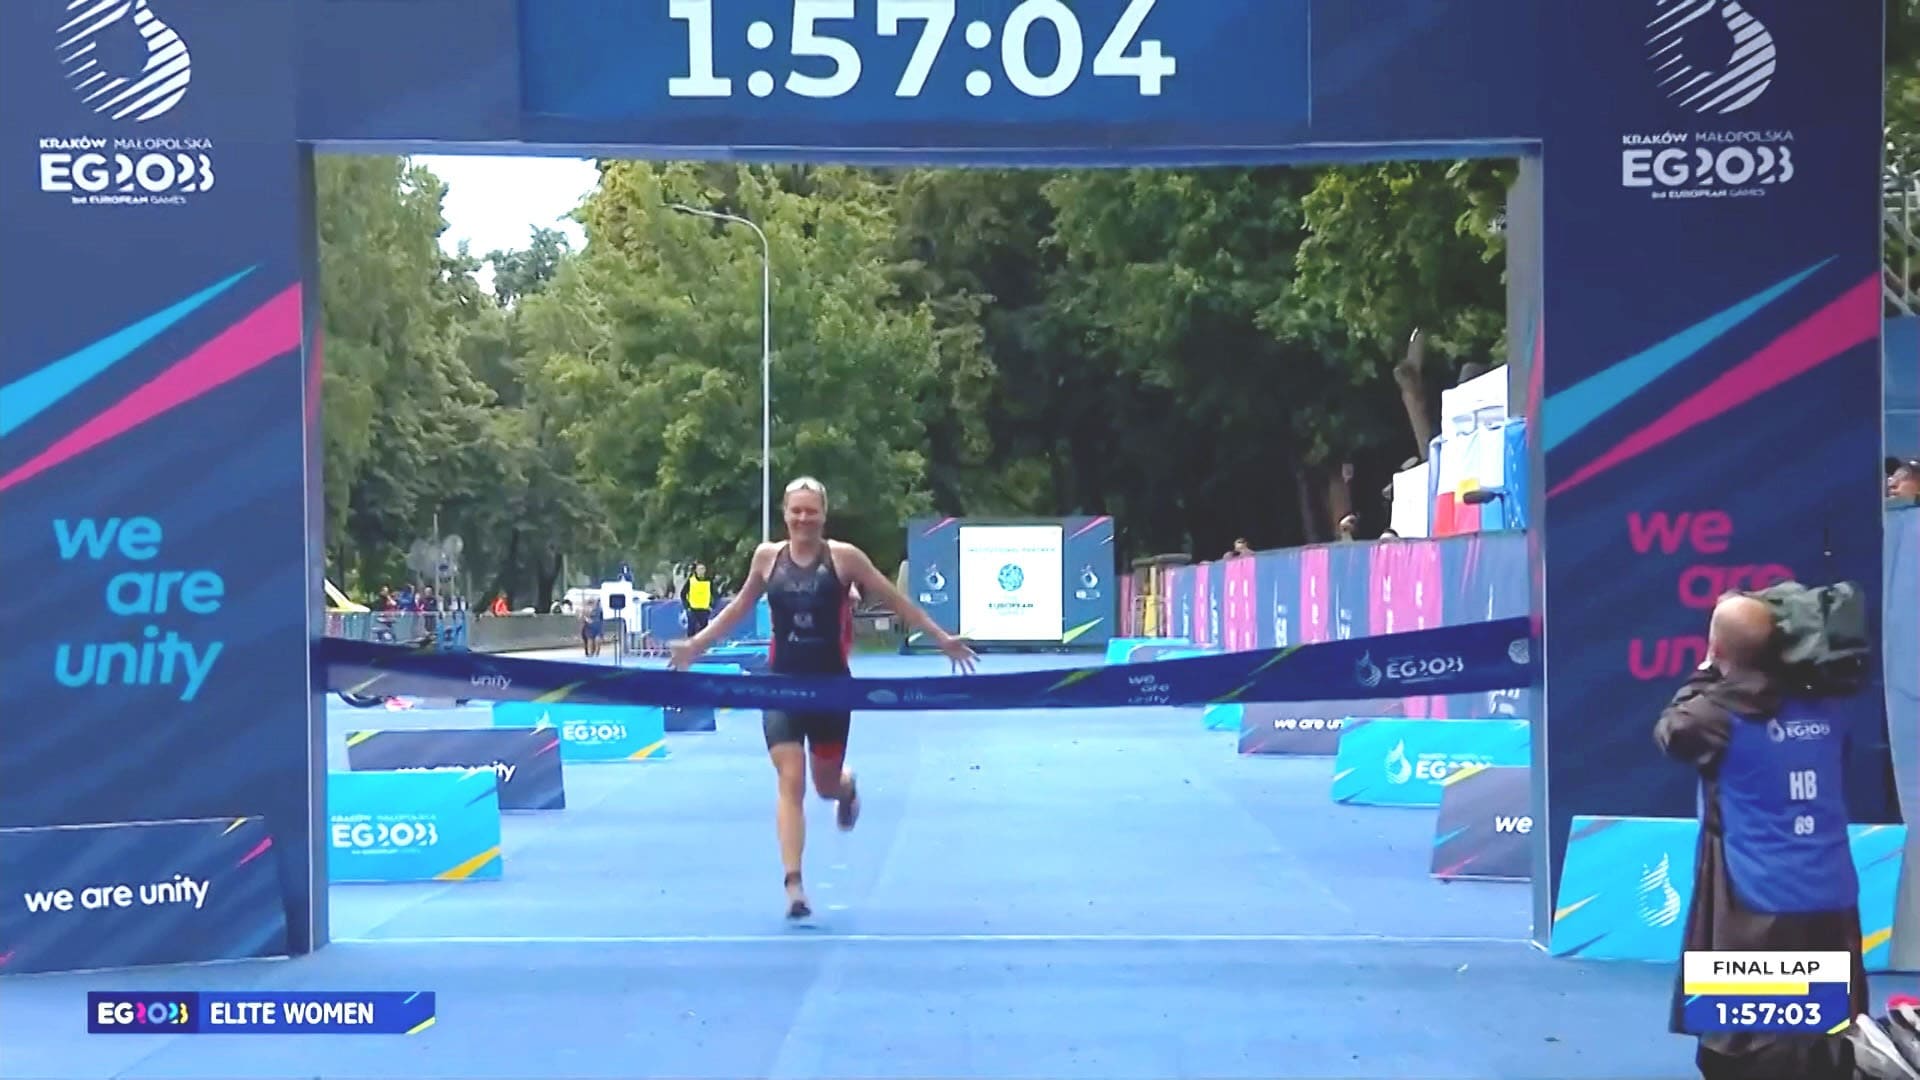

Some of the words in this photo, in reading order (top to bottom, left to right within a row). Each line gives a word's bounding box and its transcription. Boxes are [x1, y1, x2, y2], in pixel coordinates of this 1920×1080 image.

[668, 0, 1177, 98] 1:57:04
[39, 136, 107, 149] KRAKÓW
[1622, 131, 1689, 145] KRAKÓW
[1695, 130, 1795, 143] MAŁOPOLSKA
[40, 153, 215, 192] EG2023
[1622, 146, 1795, 187] EG2023
[53, 516, 163, 560] we
[1626, 509, 1734, 555] we
[106, 570, 225, 617] are
[55, 624, 226, 702] unity
[1274, 720, 1298, 730] we
[1299, 720, 1325, 730] are
[1789, 770, 1818, 801] HB
[331, 822, 440, 848] EG2023
[1495, 815, 1533, 834] we
[24, 889, 74, 912] we
[80, 885, 133, 909] are
[140, 874, 210, 909] unity
